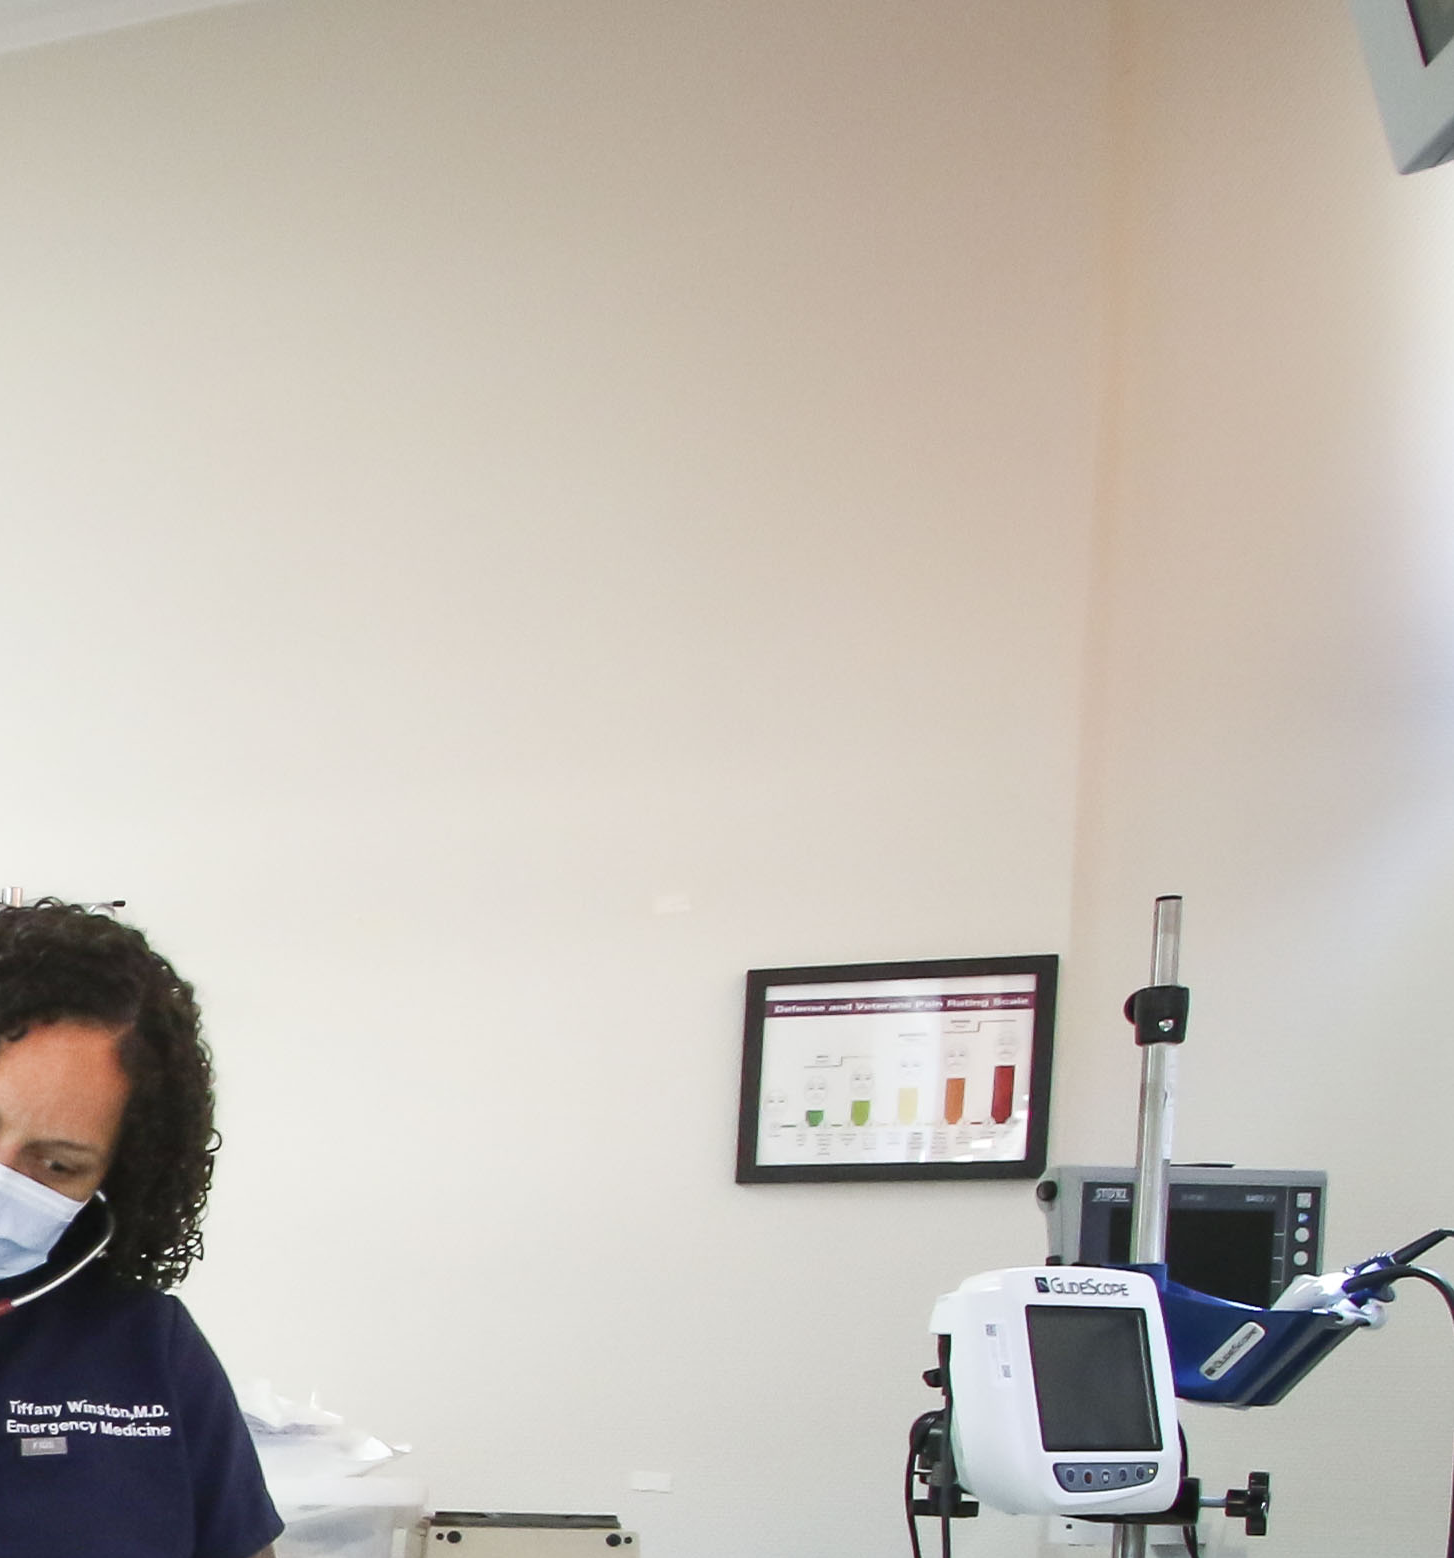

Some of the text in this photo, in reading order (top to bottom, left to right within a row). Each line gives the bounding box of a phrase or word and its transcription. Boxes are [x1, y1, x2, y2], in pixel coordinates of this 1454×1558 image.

[828, 1002, 853, 1012] and
[9, 1400, 63, 1418] Tiffany
[6, 1419, 172, 1437] Emergency Medicine
